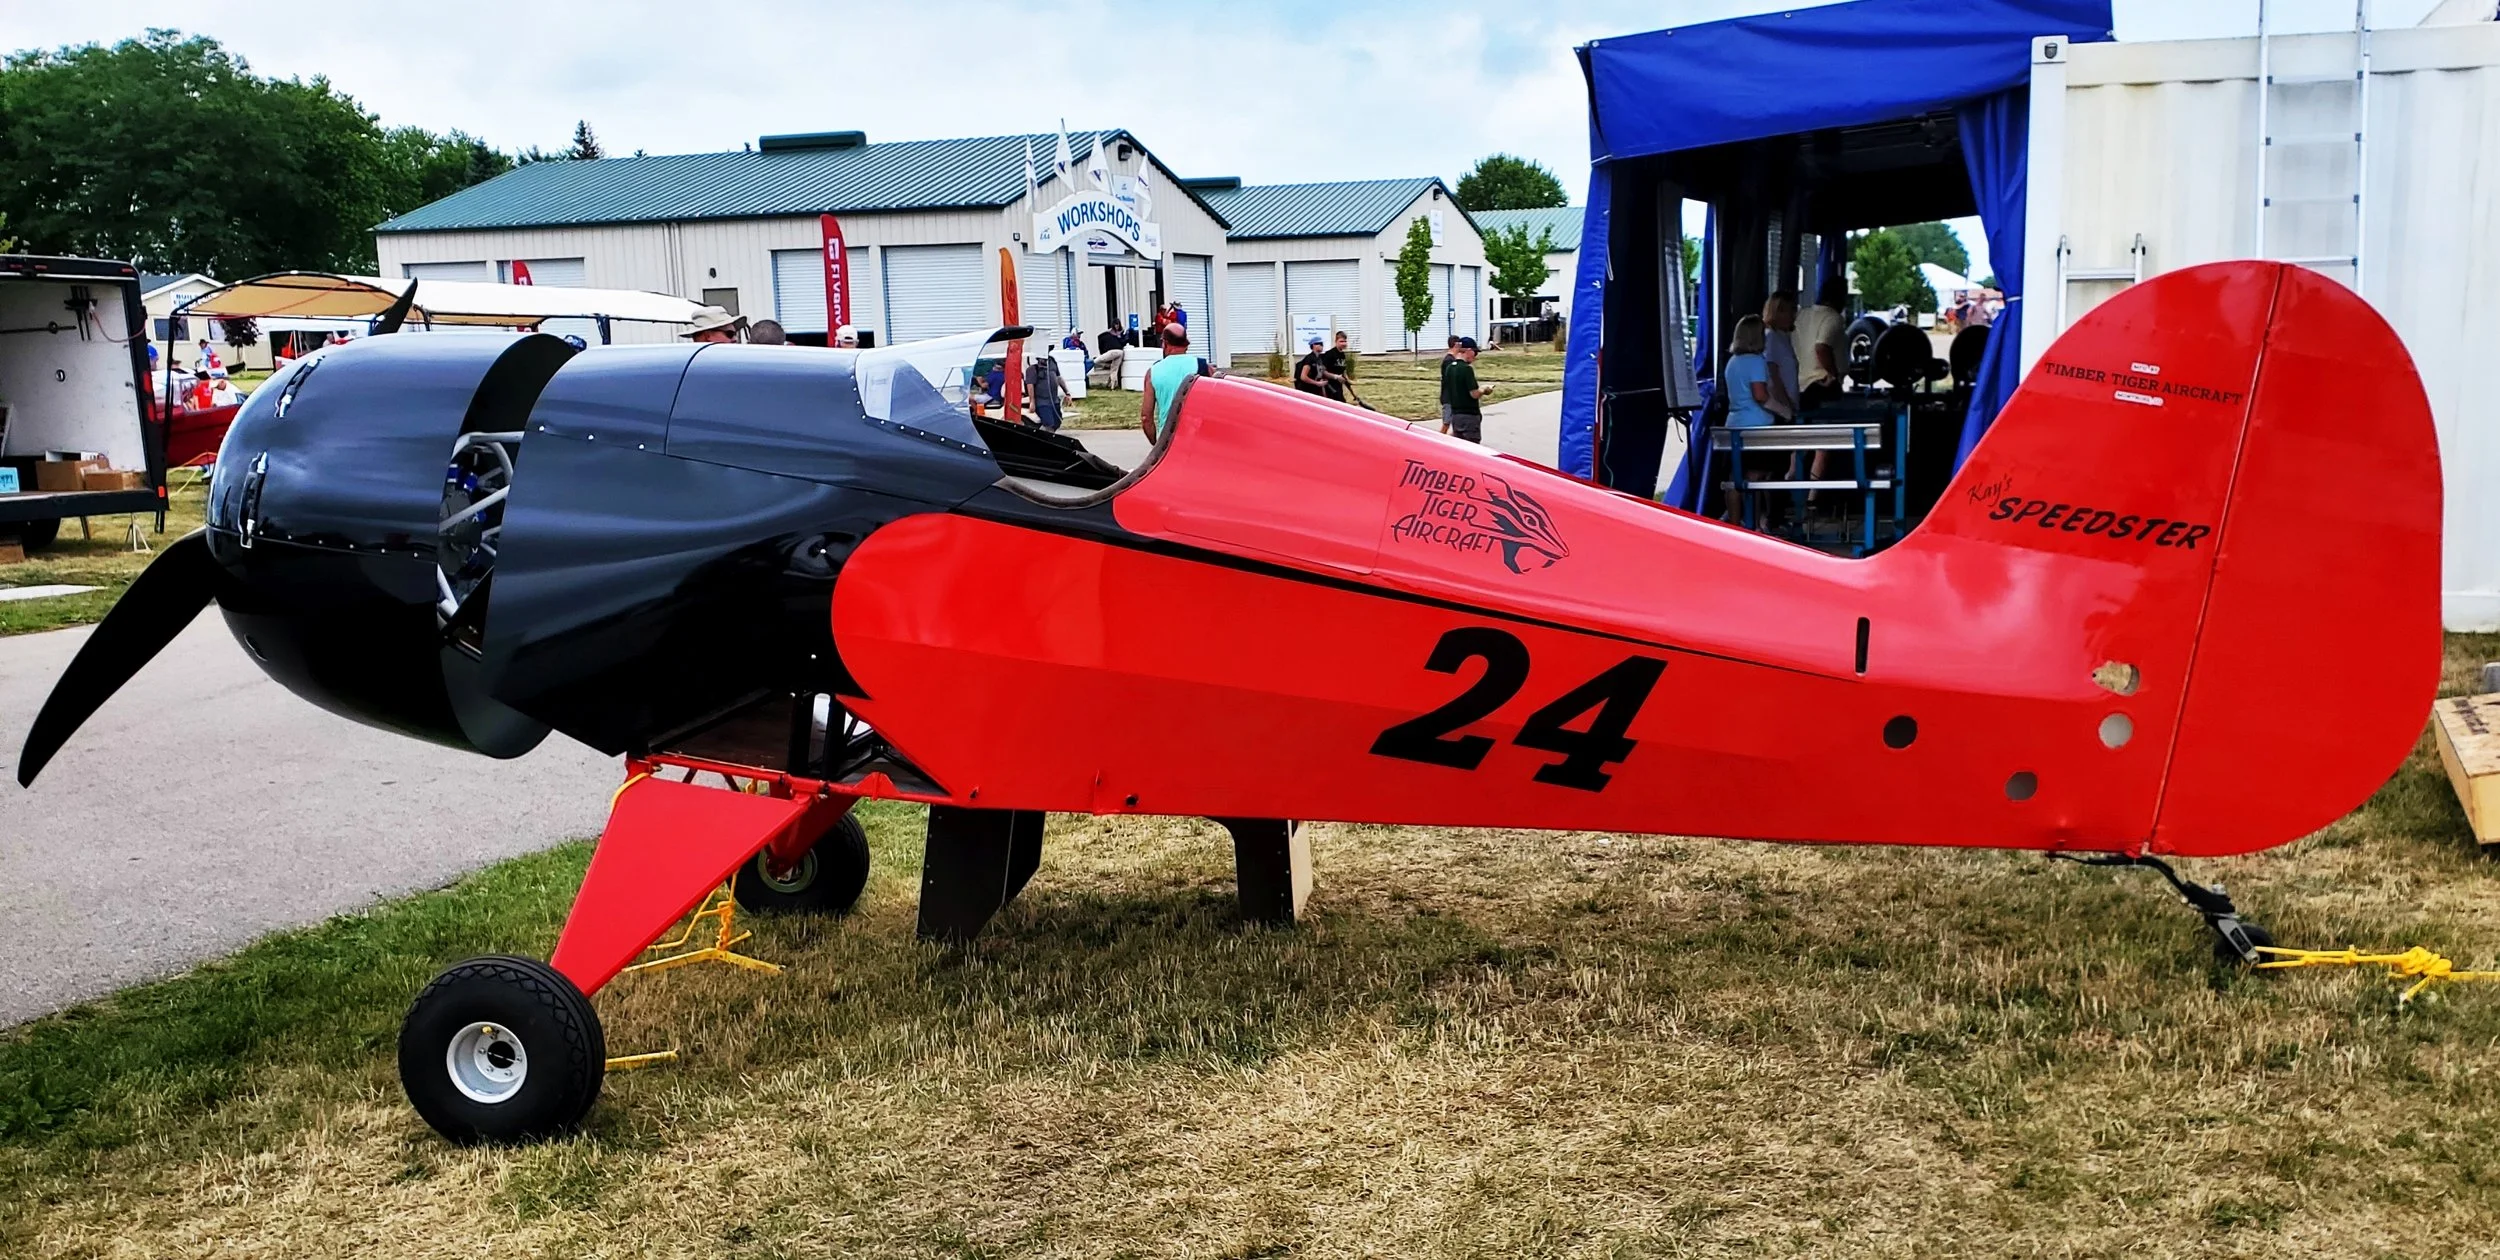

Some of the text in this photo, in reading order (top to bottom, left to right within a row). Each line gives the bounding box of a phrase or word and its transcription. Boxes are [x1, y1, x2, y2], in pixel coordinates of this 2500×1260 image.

[1057, 201, 1141, 242] WORKSHOPS
[2045, 362, 2106, 383] TIMBER
[2111, 372, 2159, 391] TIGER
[2162, 381, 2244, 406] AIRCRAFT
[1400, 459, 1476, 497] TIMBER
[1967, 473, 2012, 507] Kay's
[1419, 490, 1478, 526] TIGER
[1989, 497, 2211, 549] SPEEDSTER
[1391, 513, 1500, 554] AIRCRAFT
[1368, 626, 1669, 793] 24
